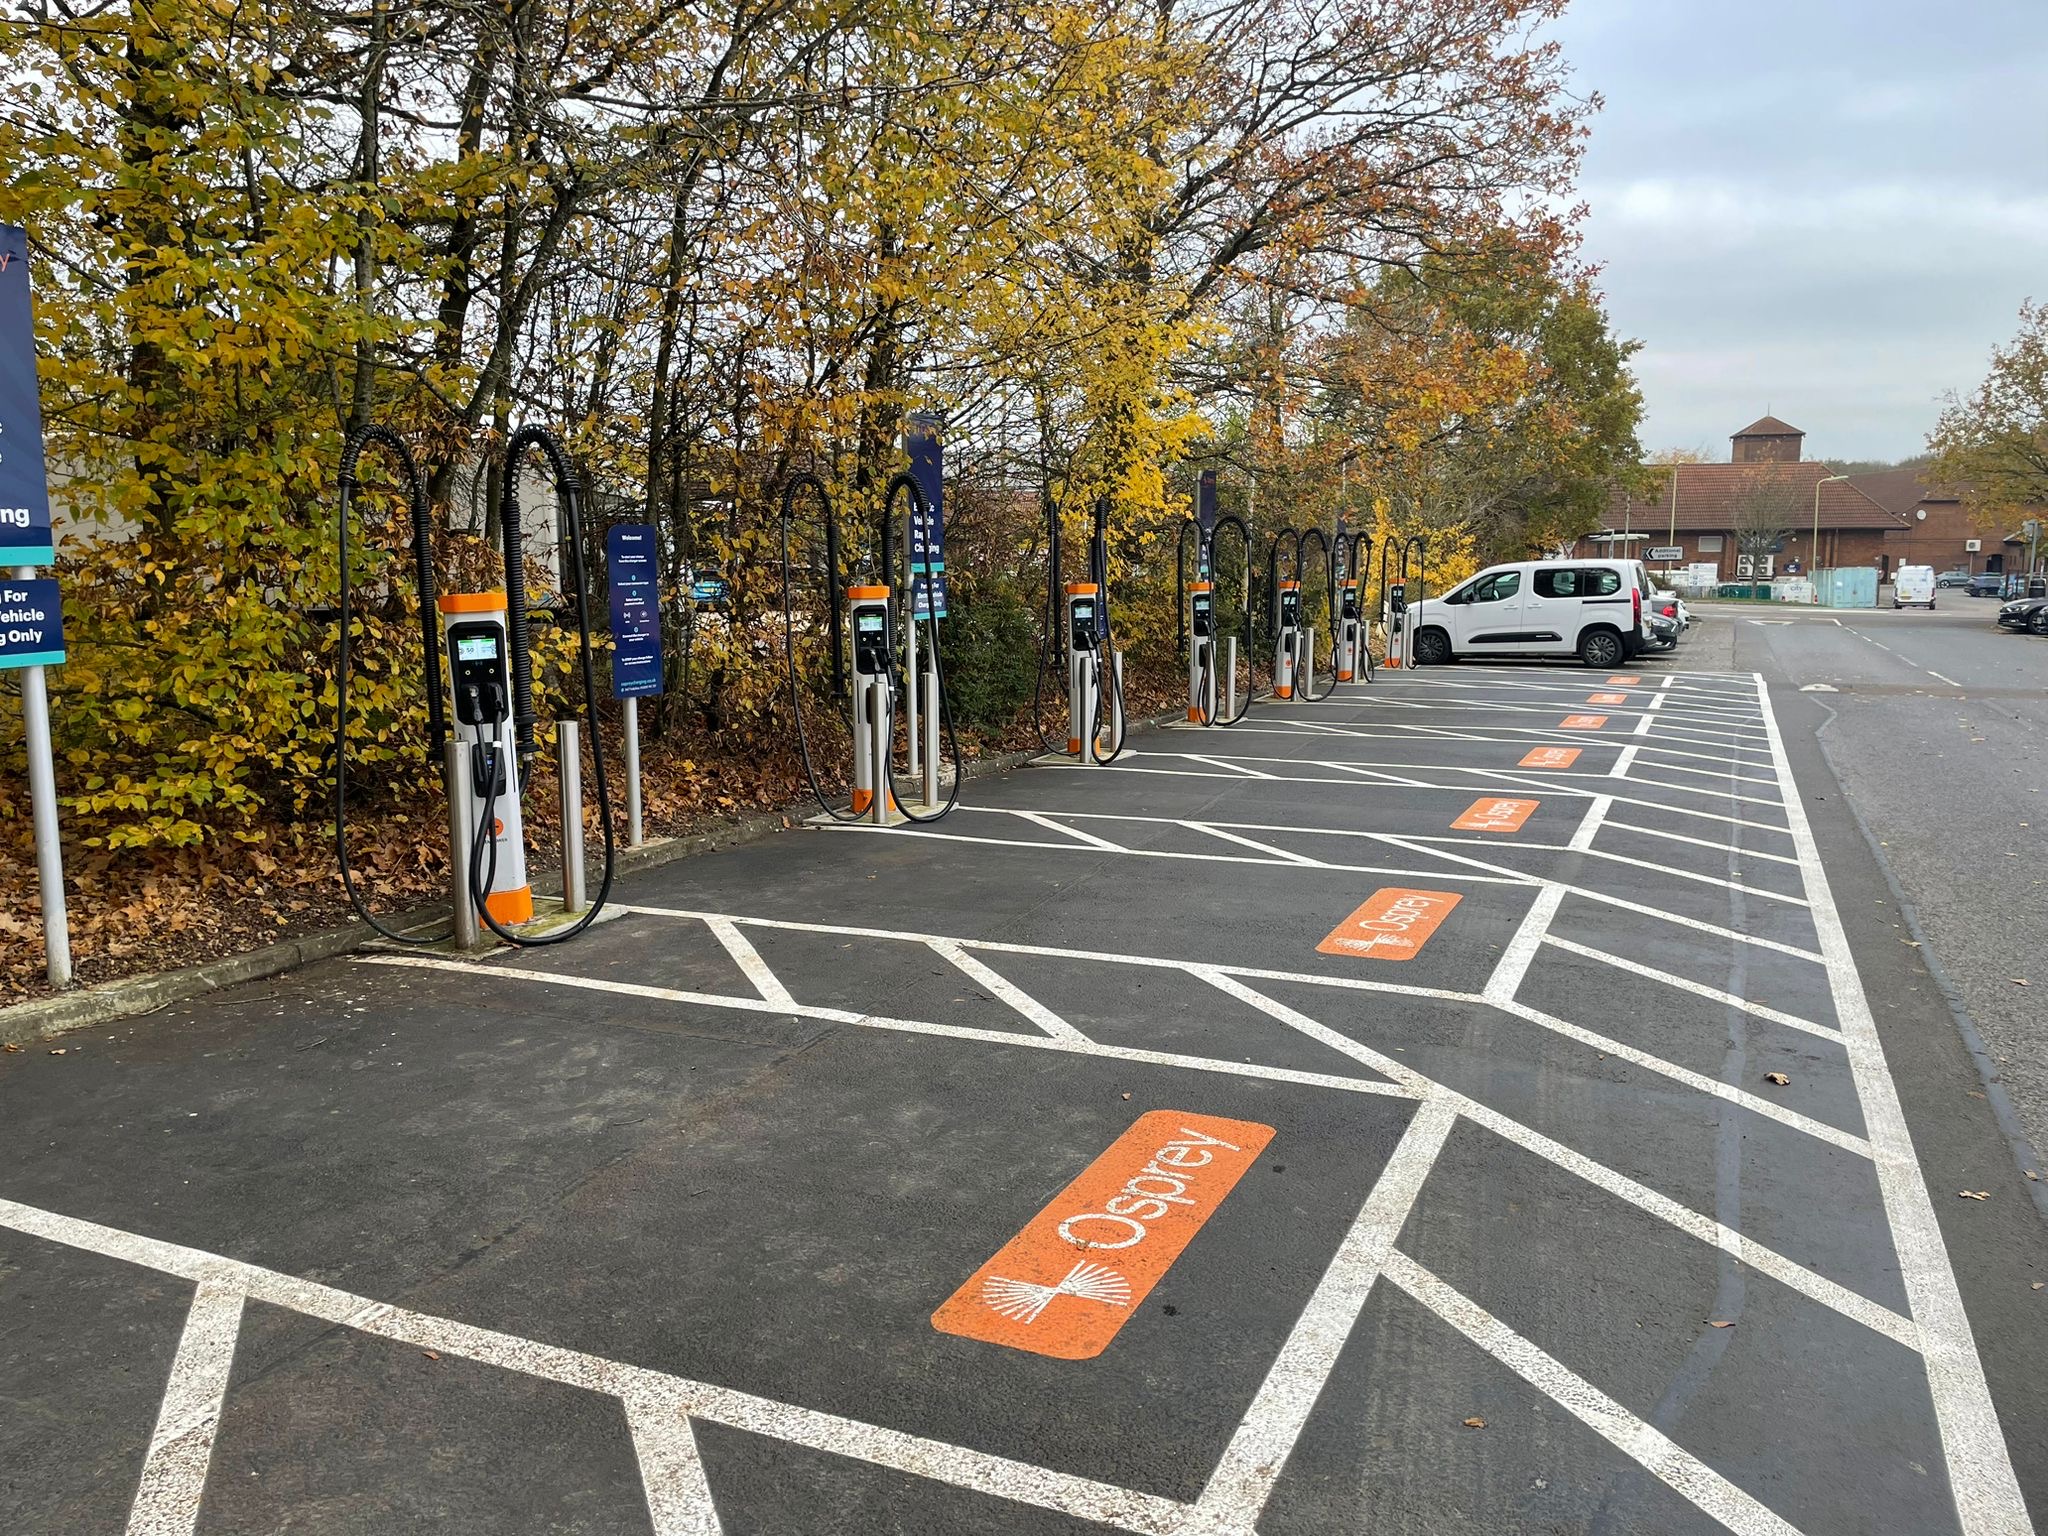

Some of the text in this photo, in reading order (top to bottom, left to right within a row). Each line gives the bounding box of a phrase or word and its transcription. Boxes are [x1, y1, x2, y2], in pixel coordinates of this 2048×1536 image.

[4, 590, 28, 603] For
[0, 608, 45, 623] ehicle
[9, 628, 43, 643] Only
[1359, 894, 1444, 931] Osprey
[1057, 1127, 1240, 1249] Osprey
